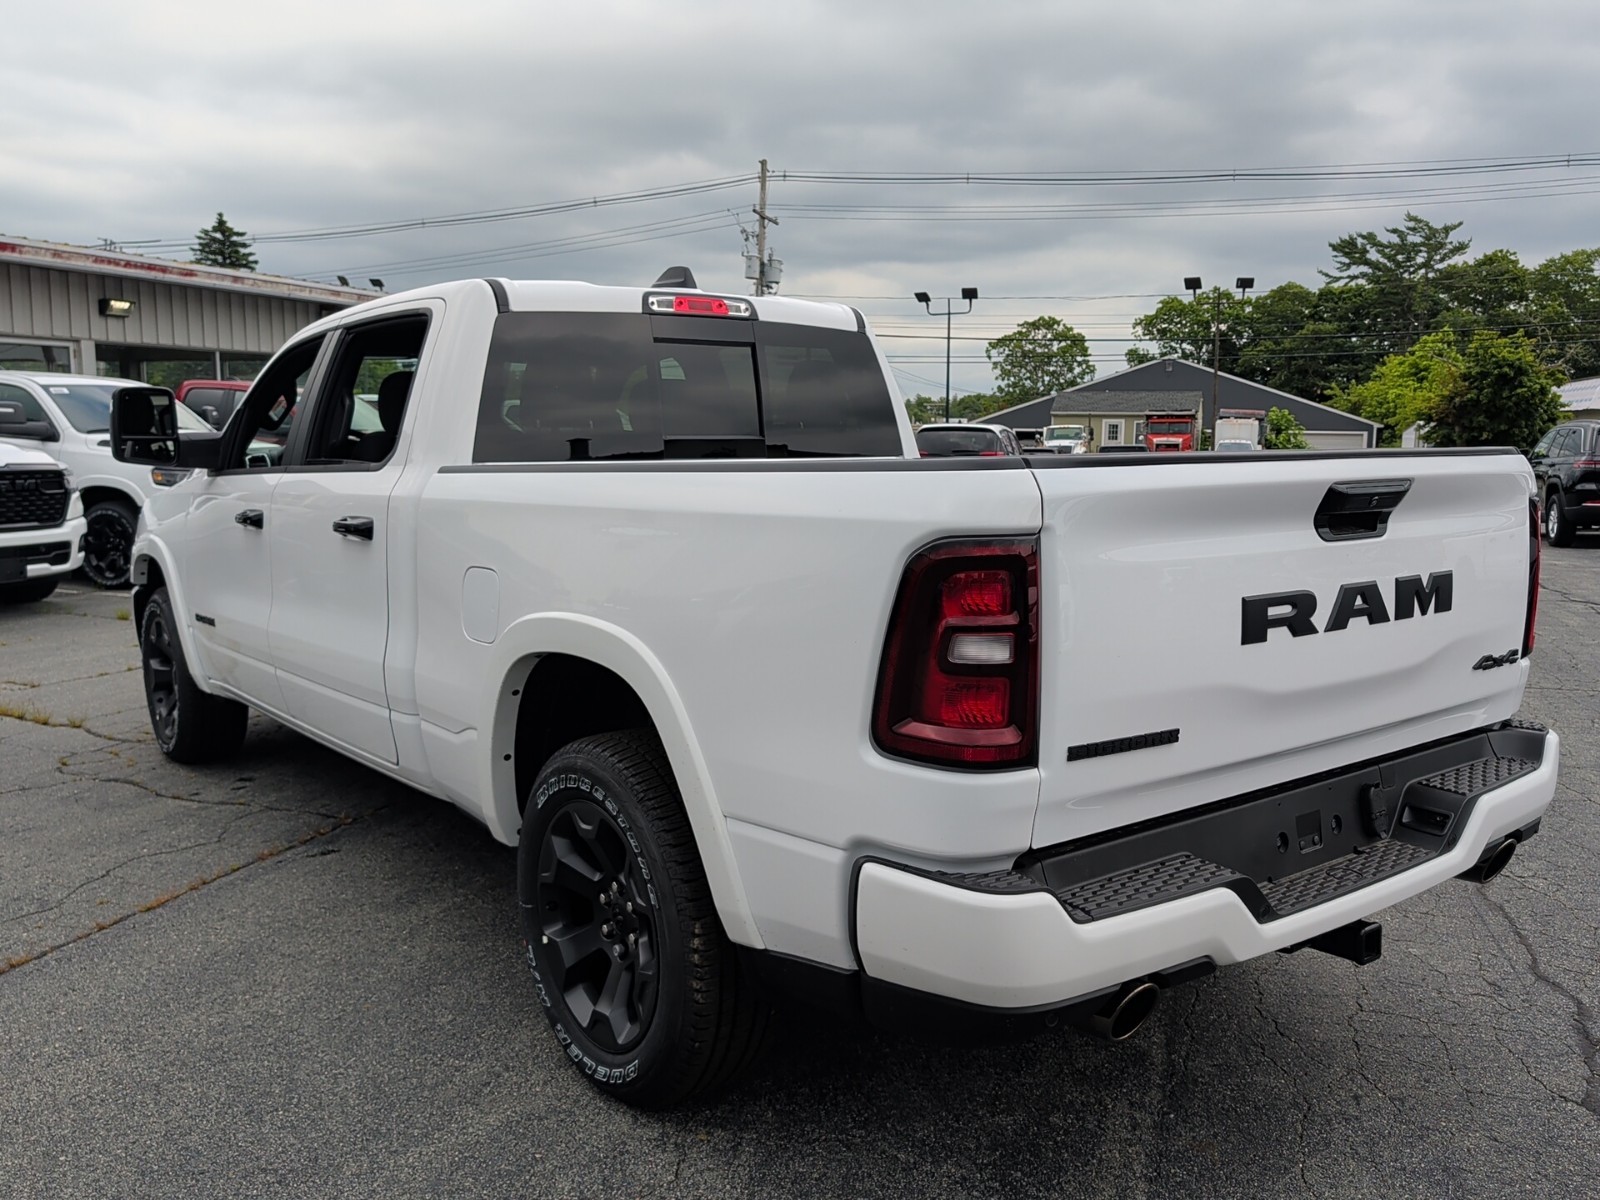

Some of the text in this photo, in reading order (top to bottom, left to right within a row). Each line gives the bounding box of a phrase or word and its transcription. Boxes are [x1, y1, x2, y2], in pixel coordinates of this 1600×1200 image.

[0, 479, 36, 490] AM
[1241, 569, 1453, 646] RAM
[536, 774, 659, 909] BRIDGESTONE
[554, 1023, 639, 1083] DUELER
